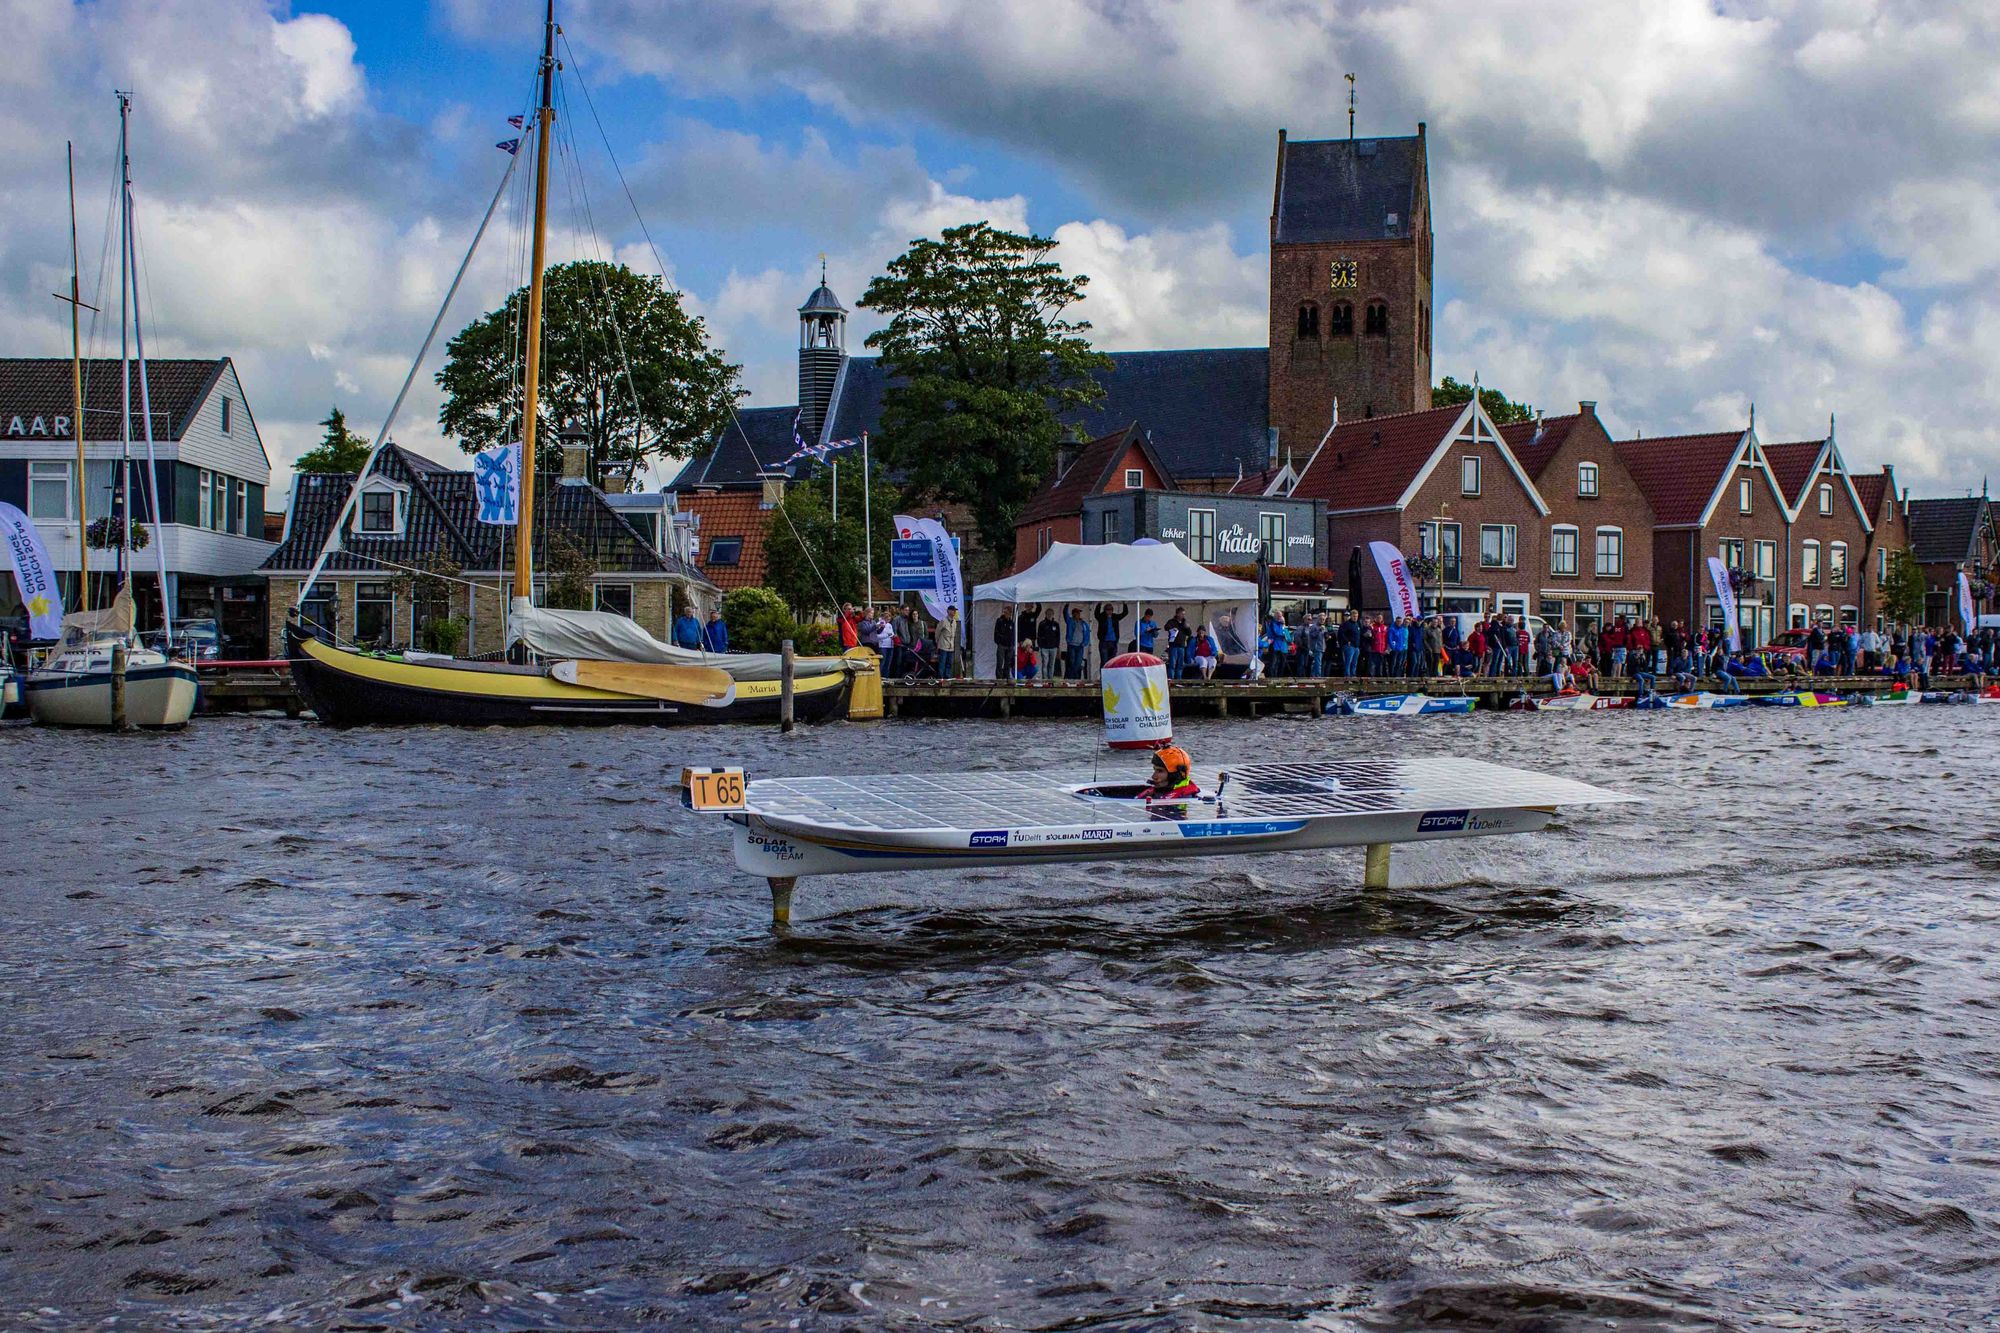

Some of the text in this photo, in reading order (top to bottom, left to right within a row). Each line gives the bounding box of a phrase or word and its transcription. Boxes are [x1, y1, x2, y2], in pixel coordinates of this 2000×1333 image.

[1162, 527, 1187, 539] lekker
[1232, 523, 1244, 536] De
[1218, 529, 1260, 554] Kade
[1287, 535, 1315, 549] gezellig
[748, 685, 777, 694] Maria
[695, 776, 741, 804] T 65
[1083, 830, 1112, 840] MARIN
[747, 836, 788, 846] SOLAR
[762, 844, 796, 853] BOAT
[775, 852, 804, 860] TEAM
